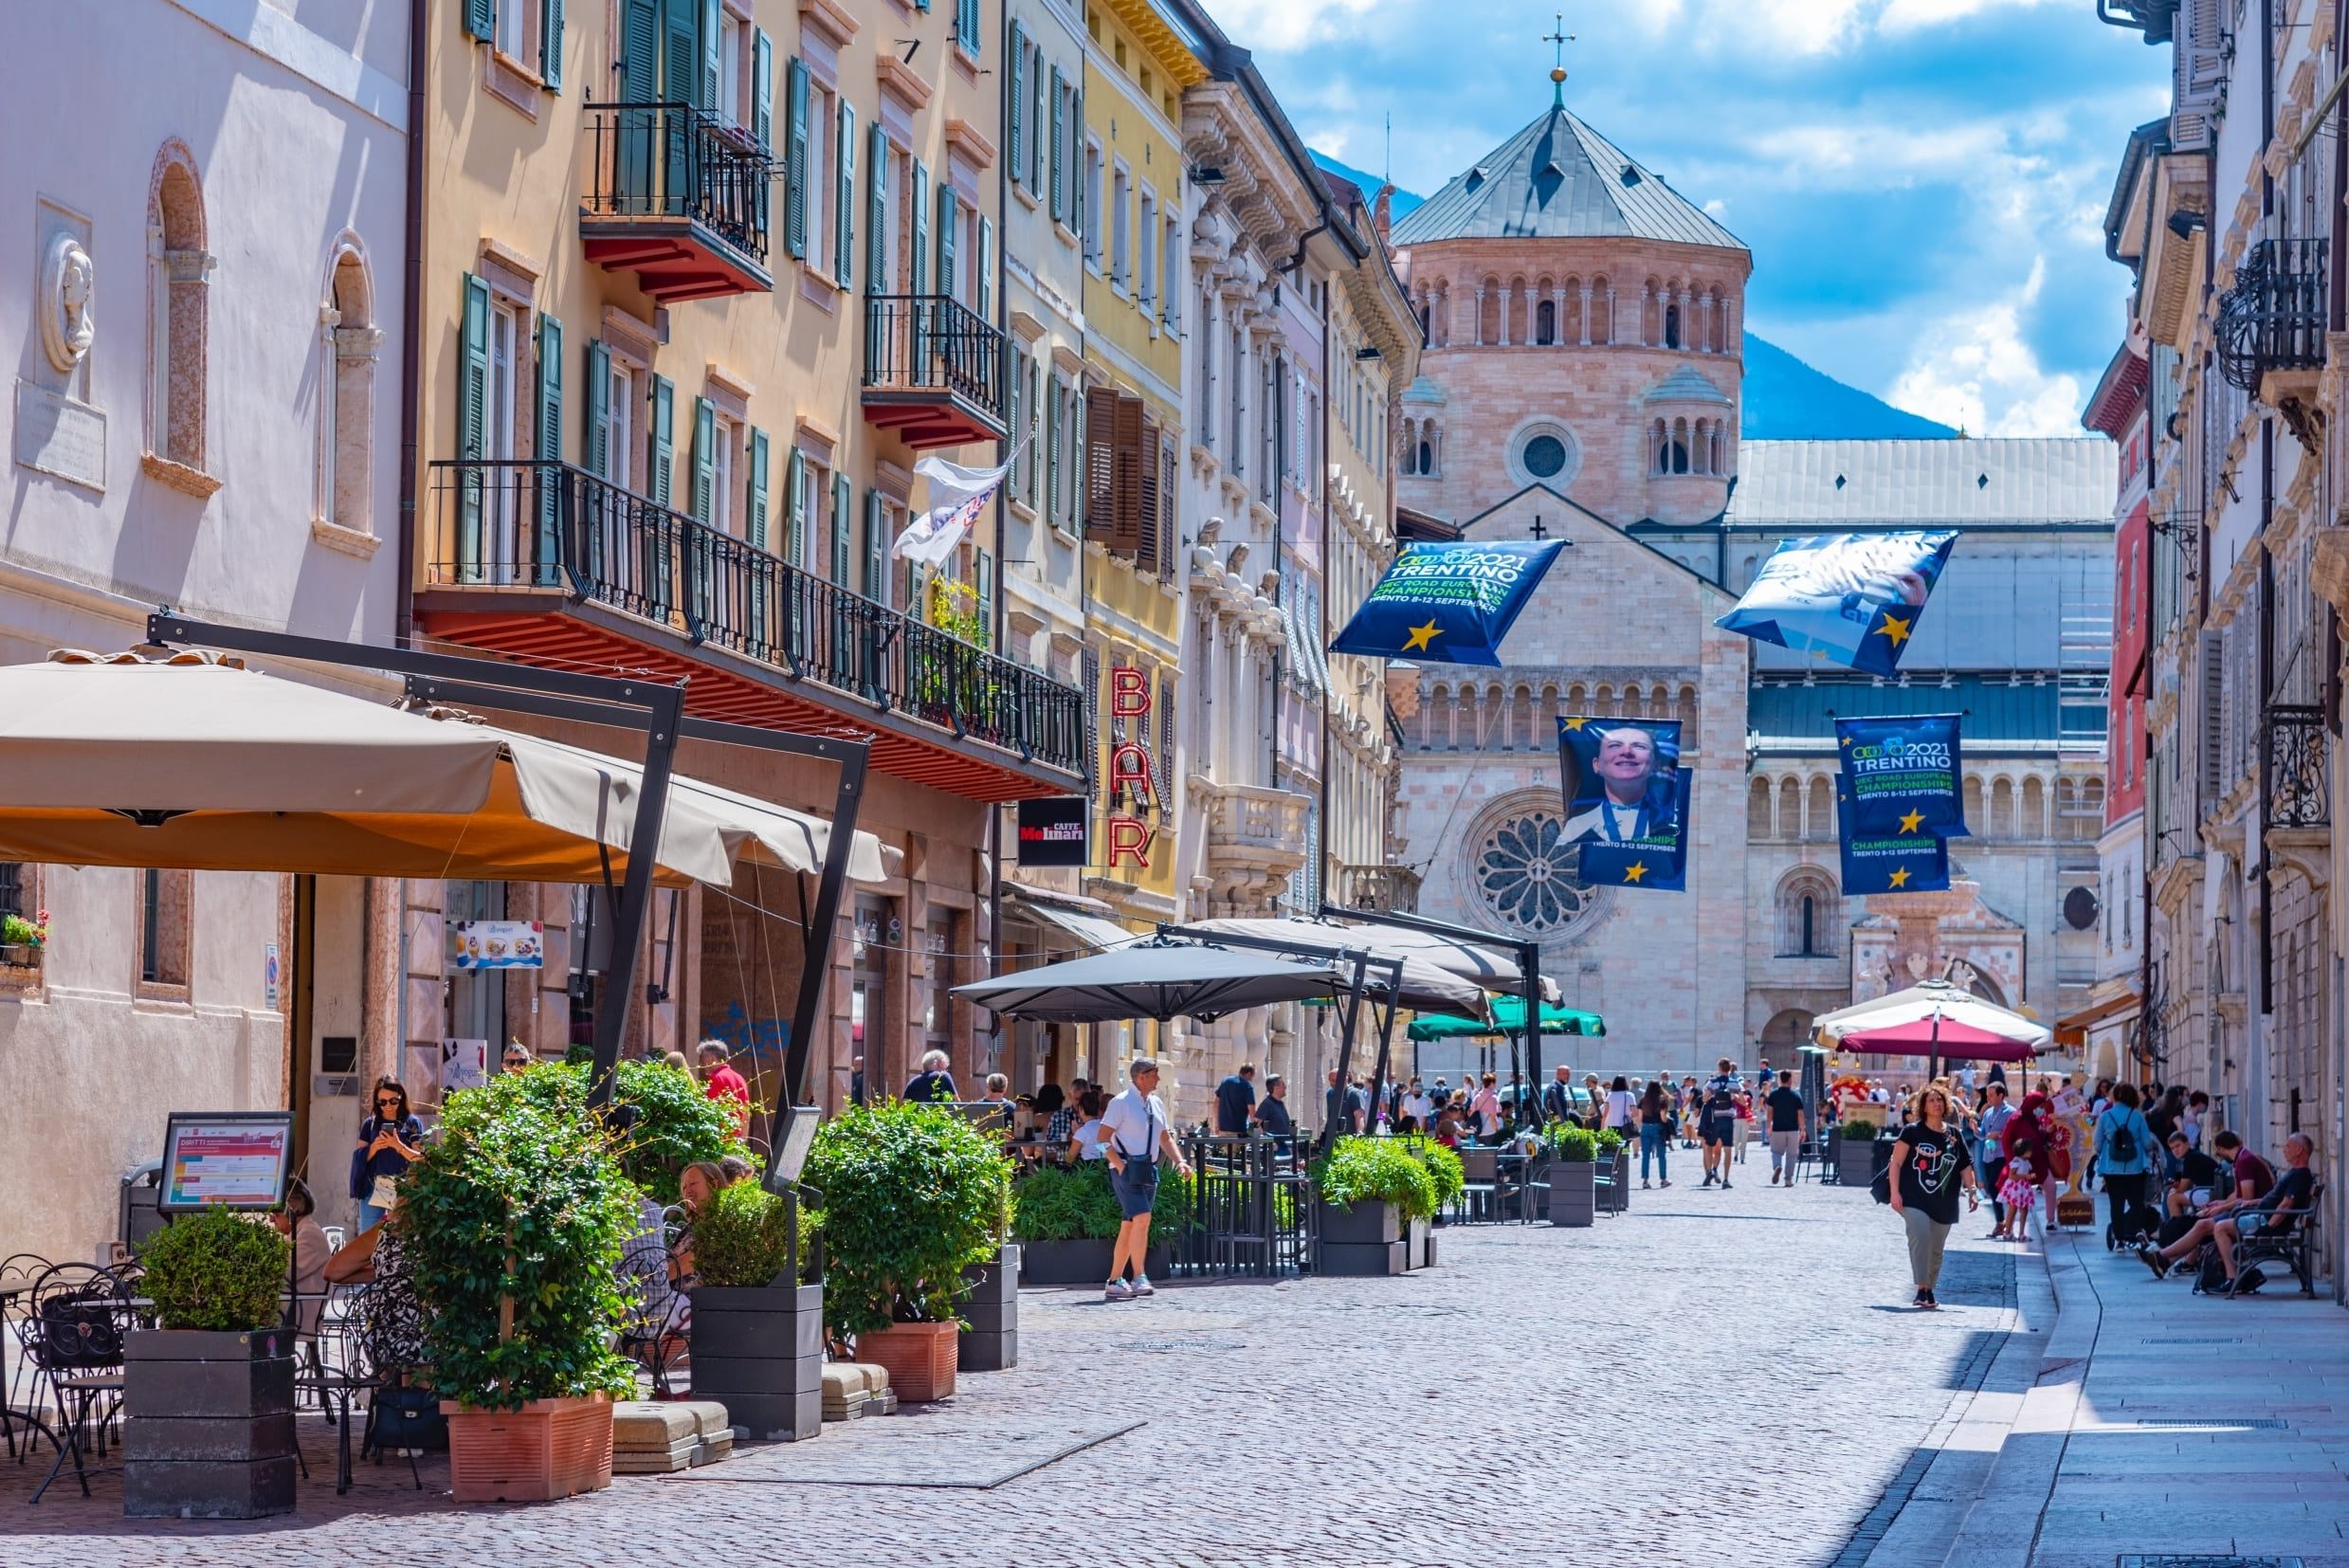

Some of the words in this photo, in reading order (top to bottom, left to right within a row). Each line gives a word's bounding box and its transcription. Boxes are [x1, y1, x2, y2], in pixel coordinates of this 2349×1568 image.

[1464, 554, 1527, 572] 2021
[1391, 564, 1518, 582] TRENTINO
[1369, 594, 1410, 604] TRENTO
[1411, 595, 1433, 604] 8-12
[1906, 742, 1951, 757] 2021
[1108, 666, 1152, 868] BAR
[1853, 756, 1952, 773] TRENTINO
[1855, 775, 1873, 786] UEC
[1875, 774, 1902, 782] ROAD
[1903, 772, 1953, 781] EUROPEAN
[1856, 779, 1954, 794] CHAMPIONSHIPS
[1857, 791, 1889, 801] TRENTO
[1908, 788, 1954, 797] SEPTEMBER
[1020, 827, 1083, 841] Molinari
[1636, 843, 1677, 852] SEPTEMBER
[1851, 839, 1938, 850] CHAMPIONSHIPS
[1852, 849, 1881, 858] TRENTO
